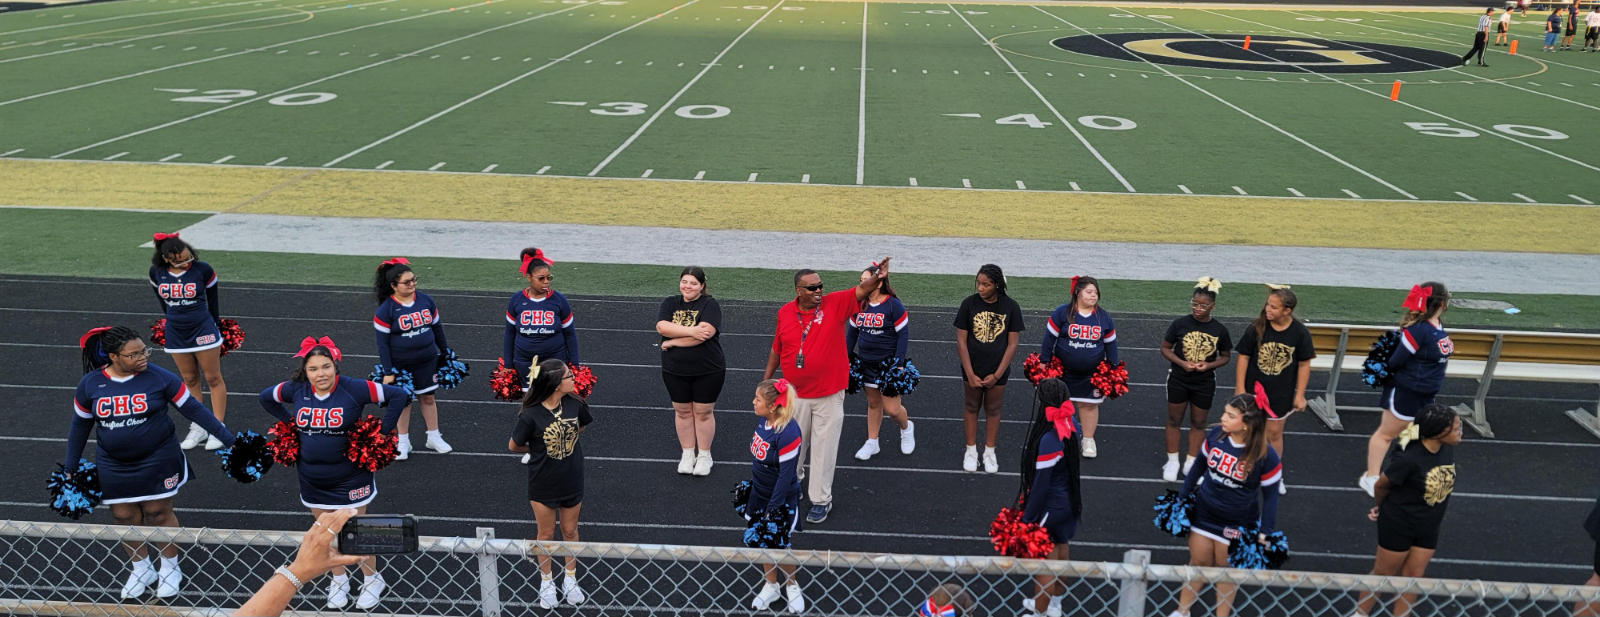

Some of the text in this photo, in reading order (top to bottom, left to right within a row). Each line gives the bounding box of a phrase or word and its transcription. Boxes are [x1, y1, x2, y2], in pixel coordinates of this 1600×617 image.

[1122, 38, 1391, 65] G
[158, 283, 197, 299] CHS
[399, 309, 433, 331] CHS
[520, 310, 555, 325] CHS
[855, 312, 885, 327] CHS
[196, 334, 215, 345] CHS
[1069, 324, 1101, 341] CHS
[96, 393, 148, 418] CHS
[296, 407, 344, 428] CHS
[1207, 448, 1248, 482] CHS
[349, 485, 371, 501] CHS
